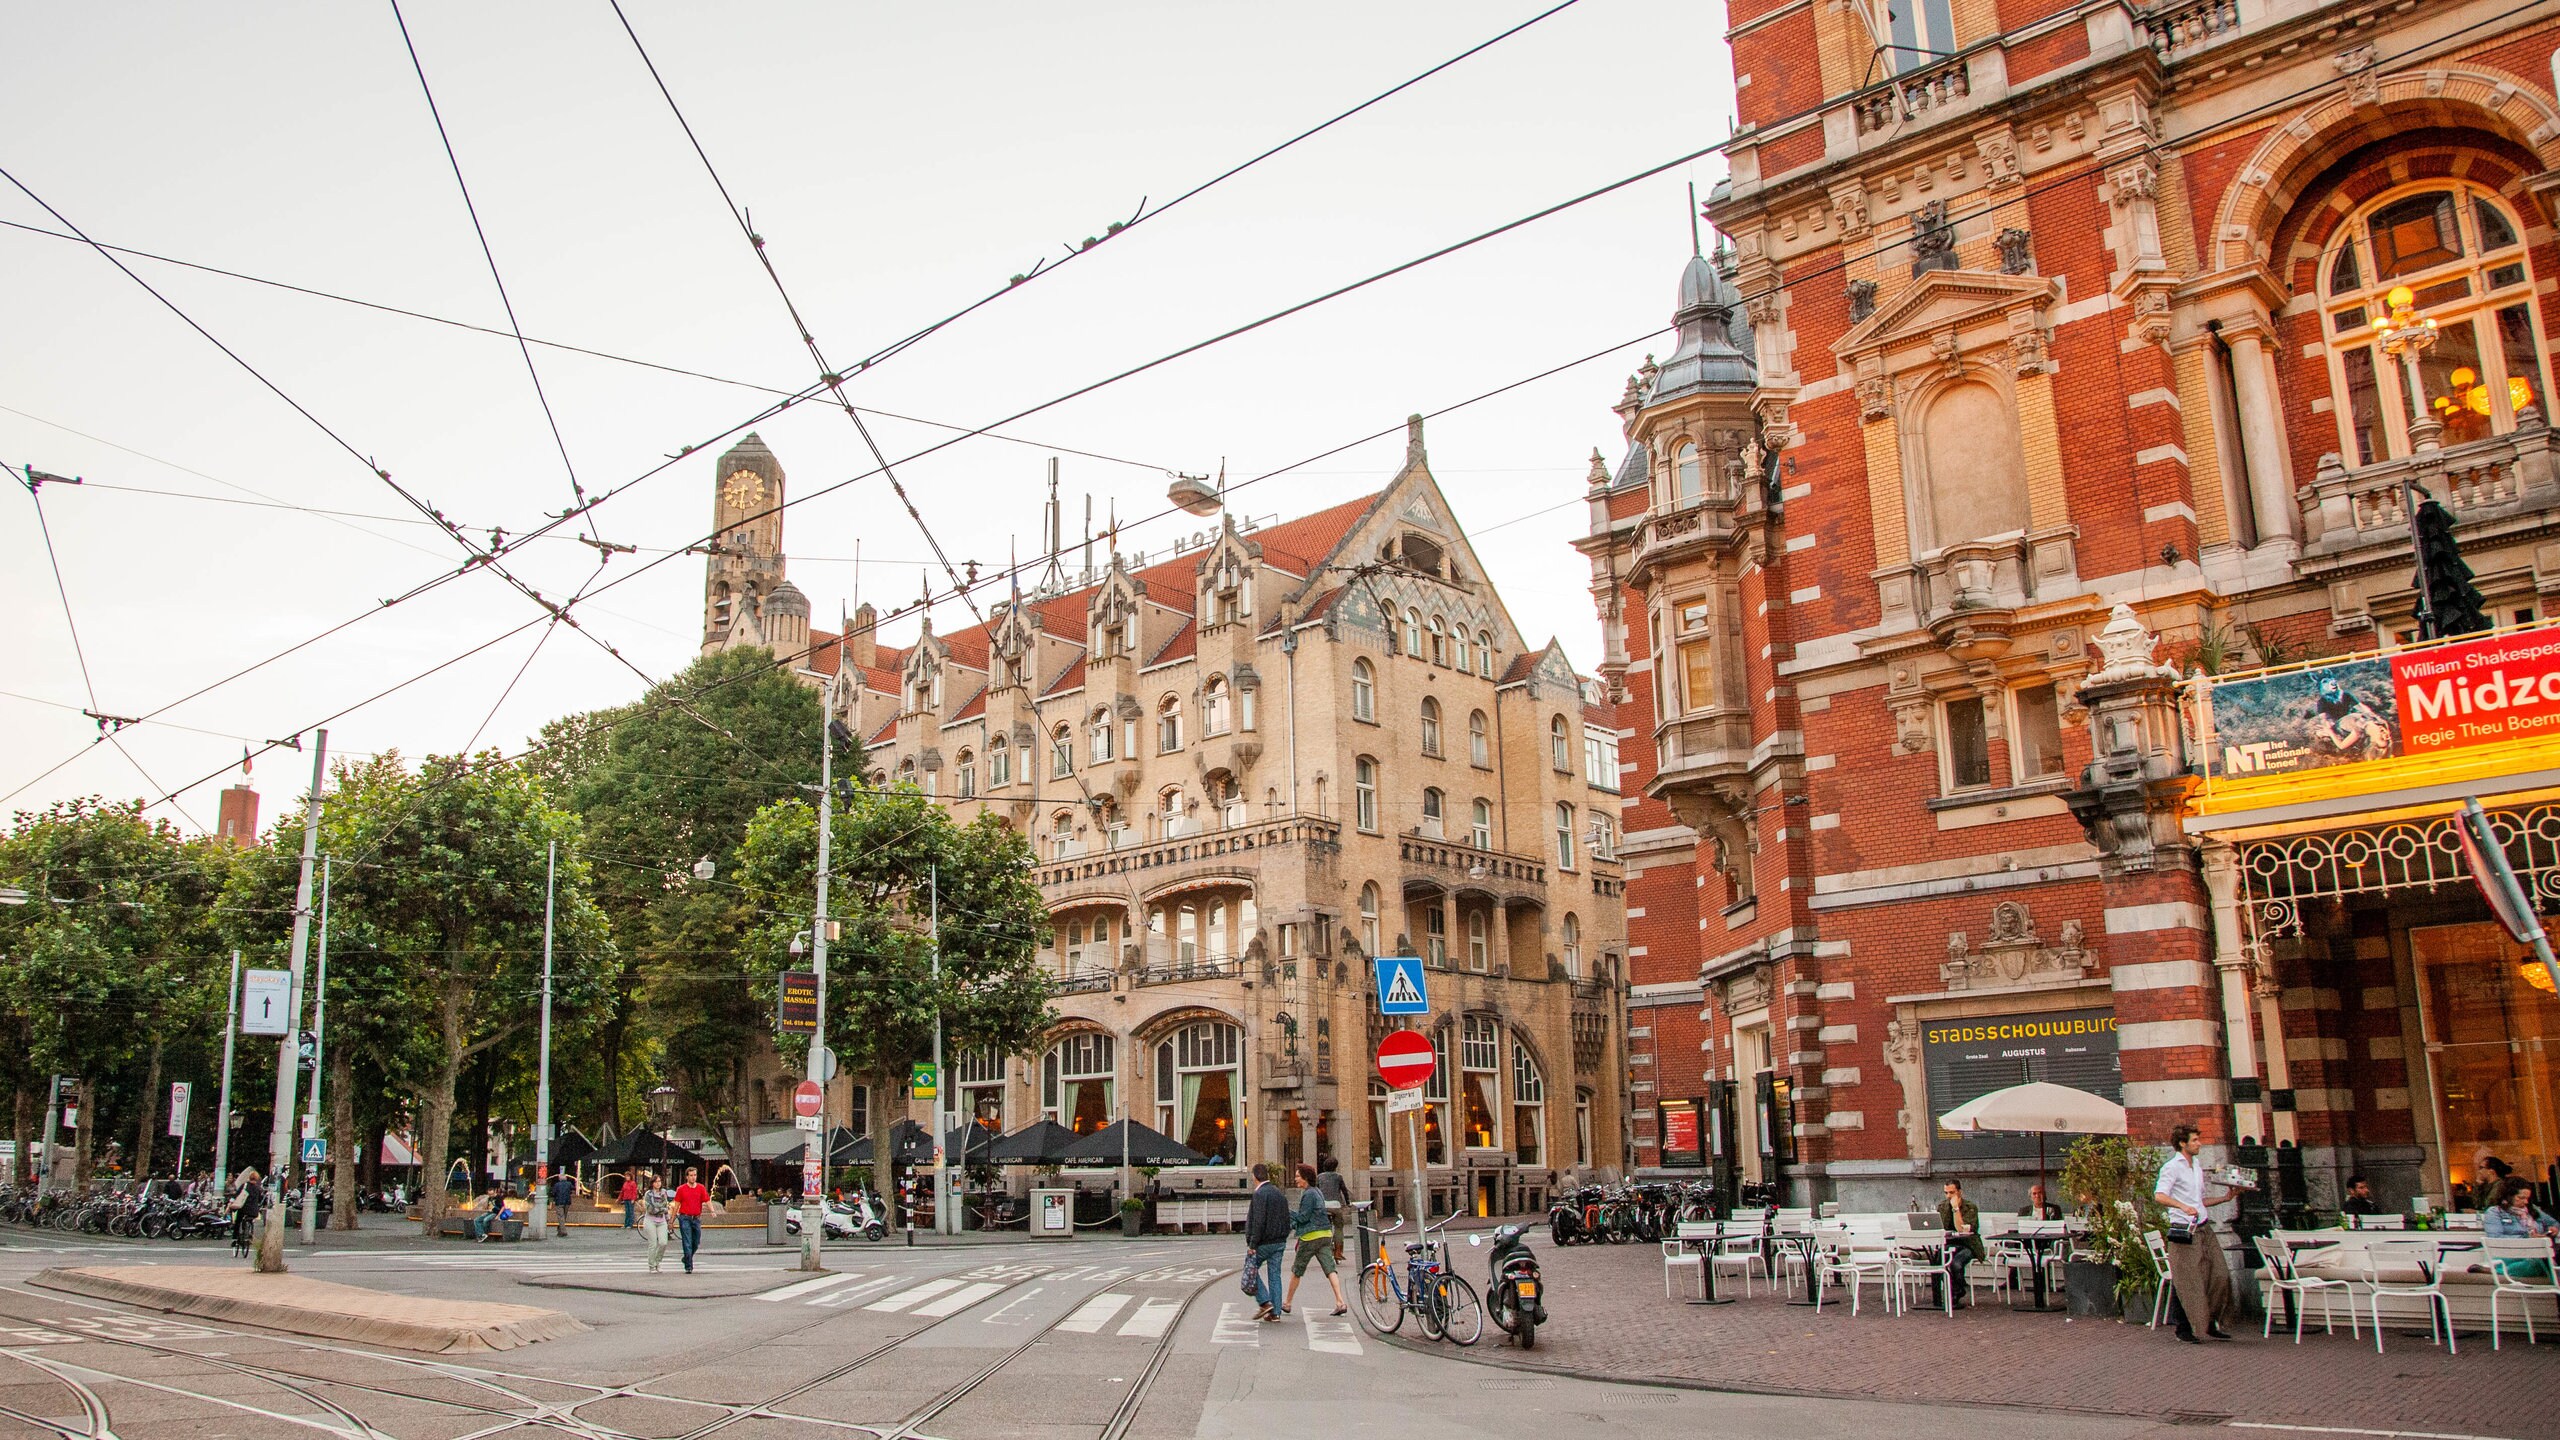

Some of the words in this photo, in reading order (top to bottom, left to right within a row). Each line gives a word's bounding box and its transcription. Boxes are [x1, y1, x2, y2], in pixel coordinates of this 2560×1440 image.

[1031, 551, 1145, 600] AMERICN
[1174, 515, 1257, 553] HOTL
[2401, 661, 2461, 680] William
[2465, 642, 2560, 669] Shakespea
[2407, 669, 2560, 723] Midzo
[2412, 728, 2456, 746] regie
[2458, 722, 2503, 738] Theu
[2270, 740, 2288, 750] het
[2225, 741, 2270, 774] NT
[2265, 746, 2311, 760] nationale
[2266, 757, 2298, 770] toneel
[787, 987, 814, 996] EROTIC
[783, 996, 817, 1005] MASSAGE
[2002, 1047, 2046, 1058] AUGUSTUS
[1064, 1156, 1077, 1164] CAFÉ
[1146, 1156, 1160, 1164] CAFÉ
